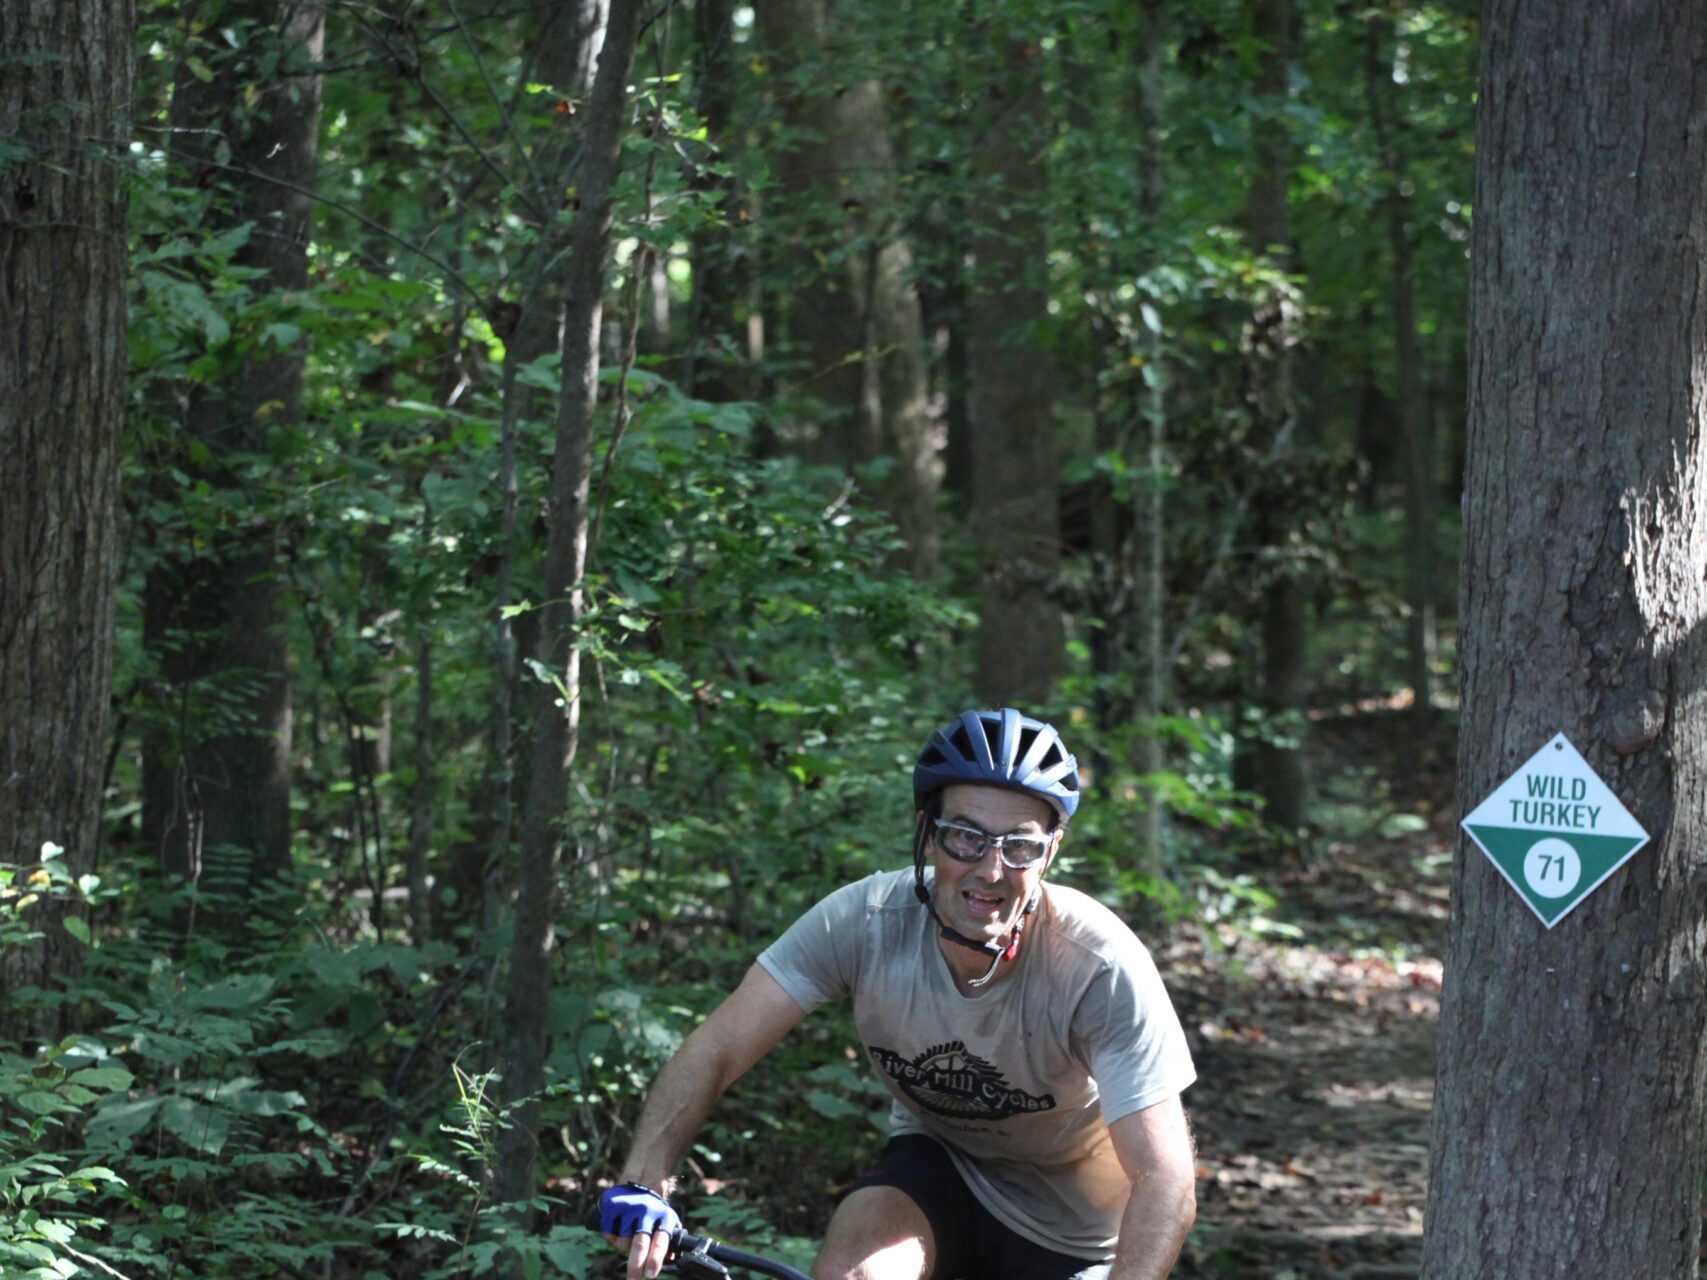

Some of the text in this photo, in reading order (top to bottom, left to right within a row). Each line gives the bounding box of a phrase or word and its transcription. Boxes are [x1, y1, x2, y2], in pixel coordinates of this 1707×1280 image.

[1526, 774, 1586, 801] WILD
[1509, 799, 1602, 829] TURKEY
[1538, 855, 1565, 881] 71
[934, 1071, 974, 1092] Mill
[982, 1083, 1050, 1111] Cycles
